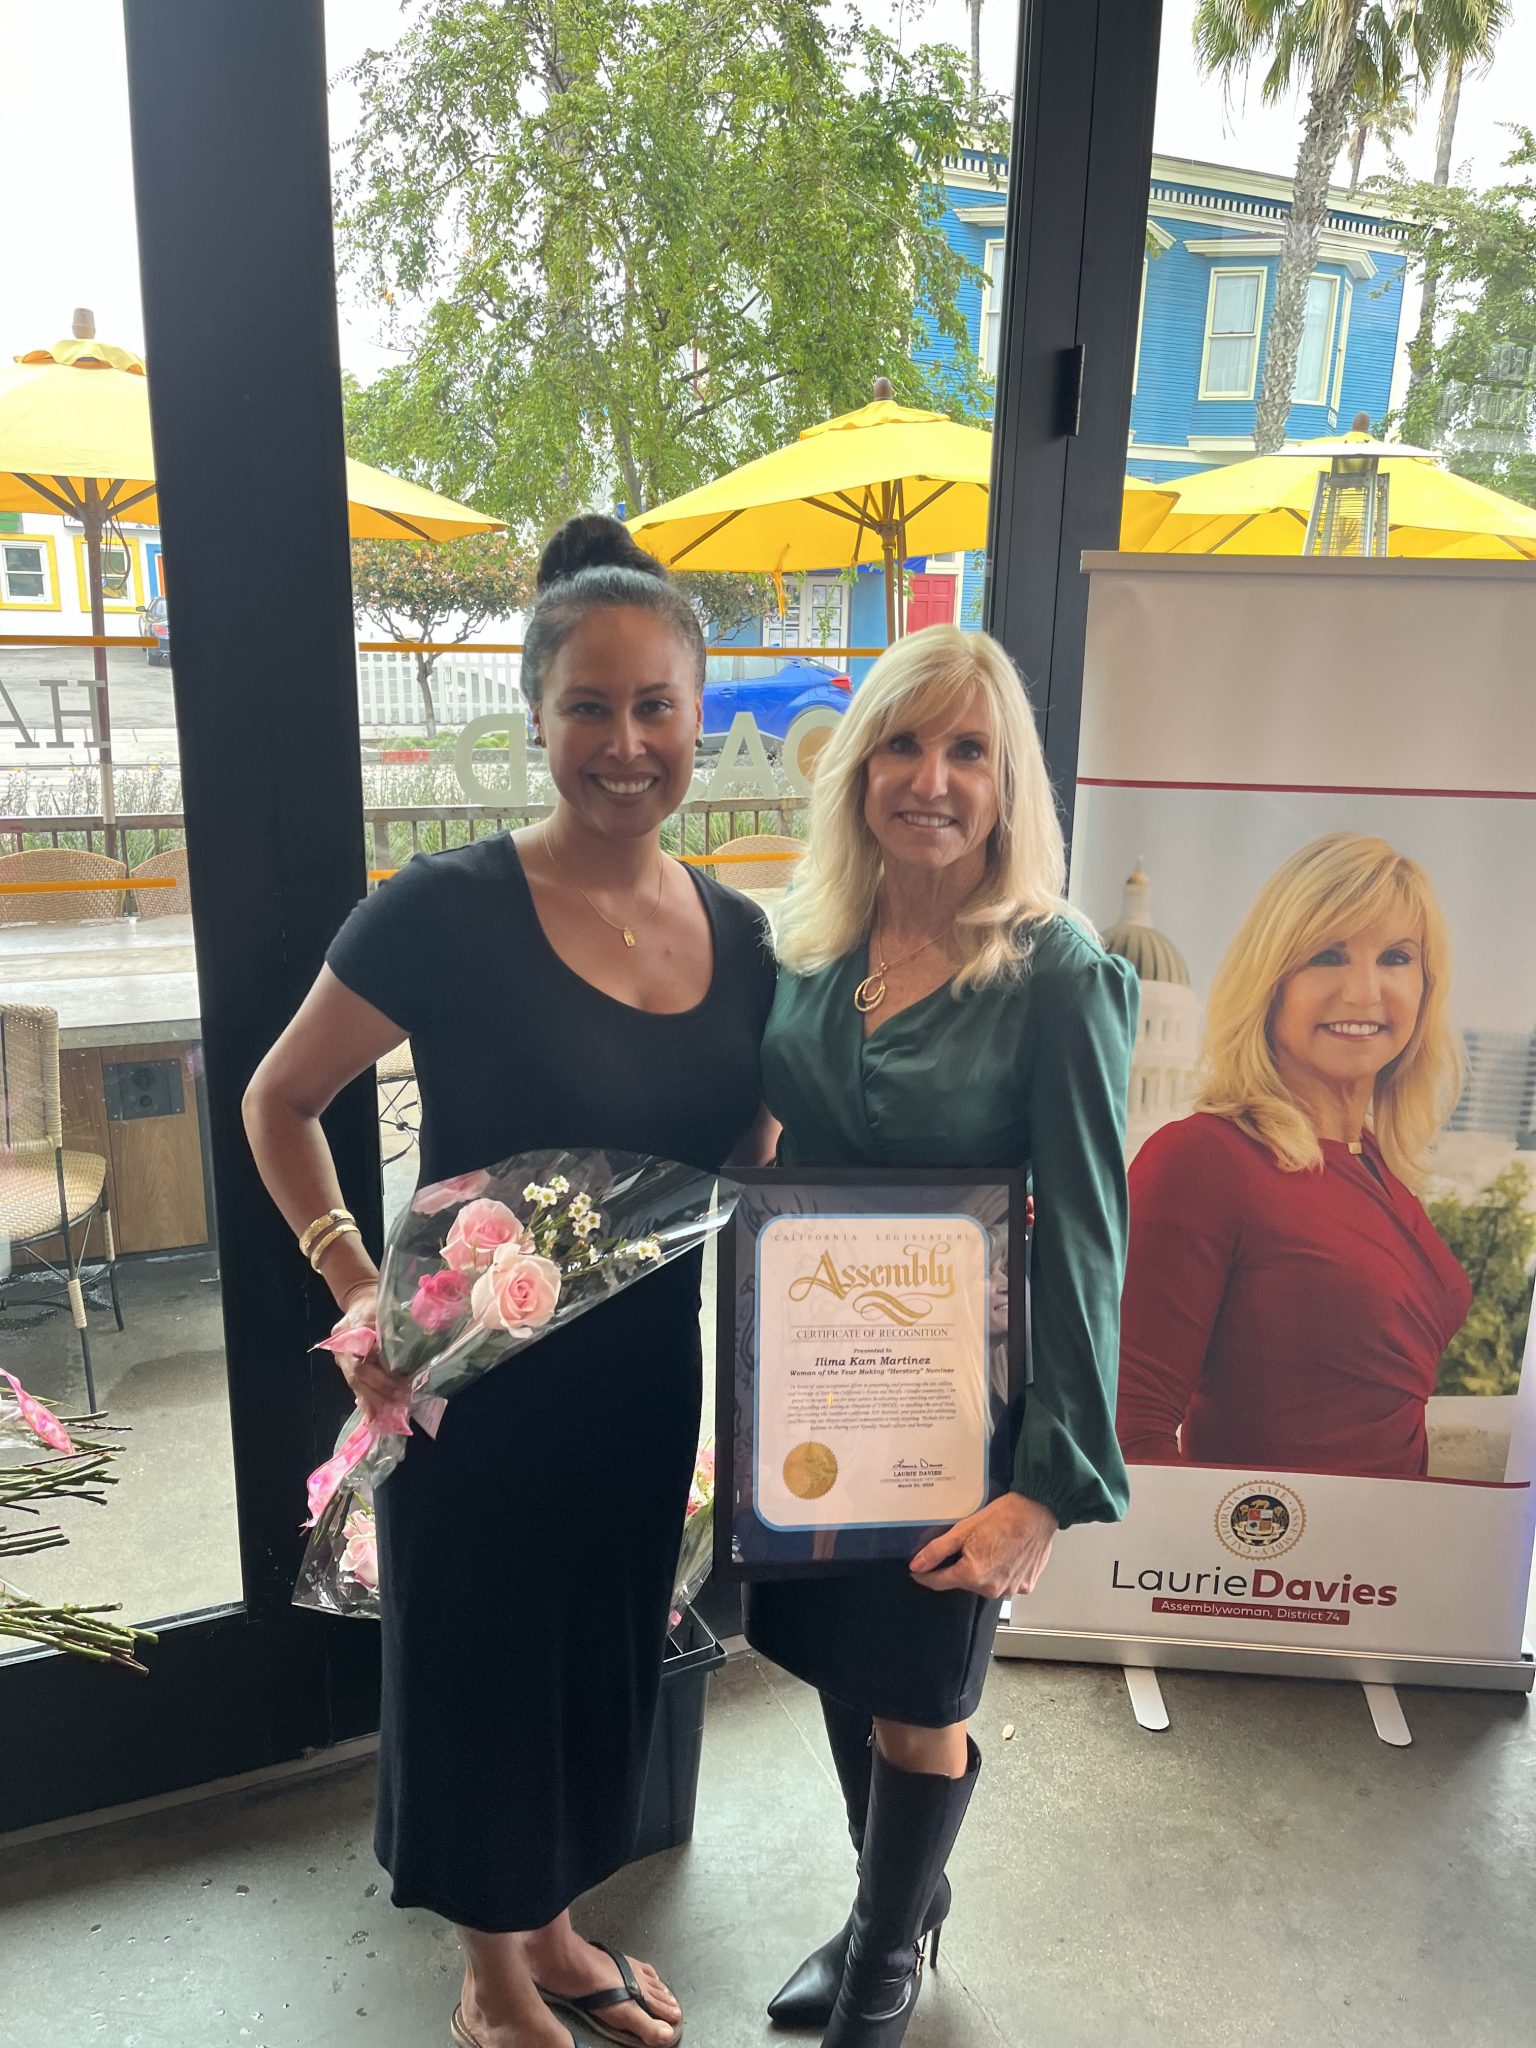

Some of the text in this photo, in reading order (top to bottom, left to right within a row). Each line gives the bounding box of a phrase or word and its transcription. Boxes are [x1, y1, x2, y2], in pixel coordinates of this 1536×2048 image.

[789, 1242, 956, 1326] Assembly
[796, 1328, 949, 1339] CERTIFICATE OF RECOGNITION
[815, 1356, 931, 1367] Ilima Kam Martinez
[818, 1369, 826, 1377] of
[859, 1368, 885, 1376] Making
[1220, 1484, 1299, 1555] STATE ASSEMBLY CALIFORNIA
[1160, 1600, 1340, 1622] Assemblywoman, District 74
